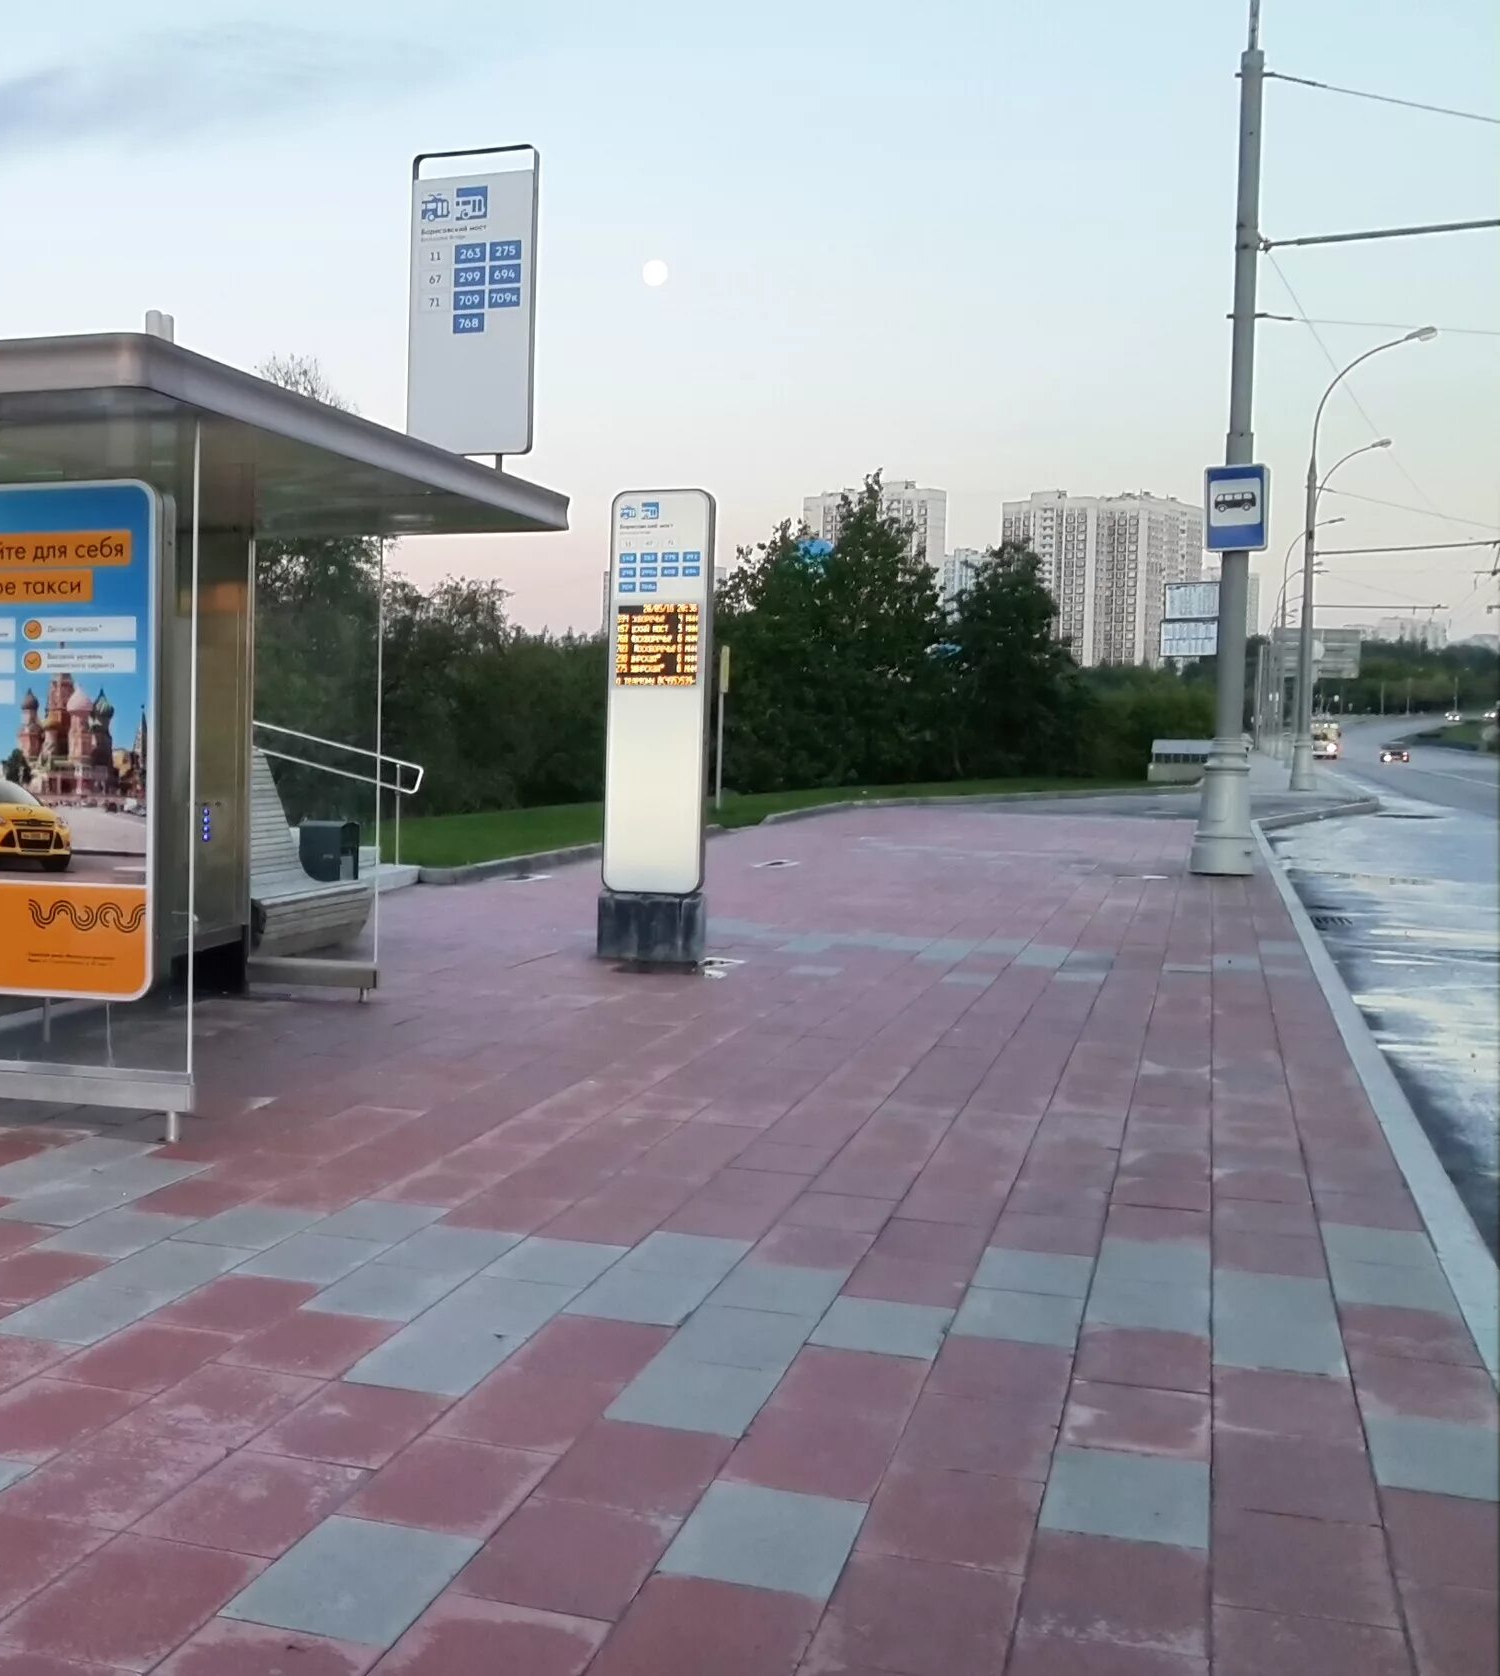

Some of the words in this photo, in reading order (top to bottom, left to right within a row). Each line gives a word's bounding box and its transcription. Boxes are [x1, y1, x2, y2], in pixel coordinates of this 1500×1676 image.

[430, 251, 441, 261] 11
[460, 248, 481, 259] 263
[495, 245, 516, 256] 275
[429, 275, 441, 284] 67
[460, 271, 480, 282] 299
[494, 269, 515, 279] 694
[429, 298, 440, 307] 71
[459, 295, 480, 305] 709
[459, 318, 479, 328] 768
[32, 541, 68, 562] для
[75, 536, 124, 558] себя
[24, 578, 81, 595] такси
